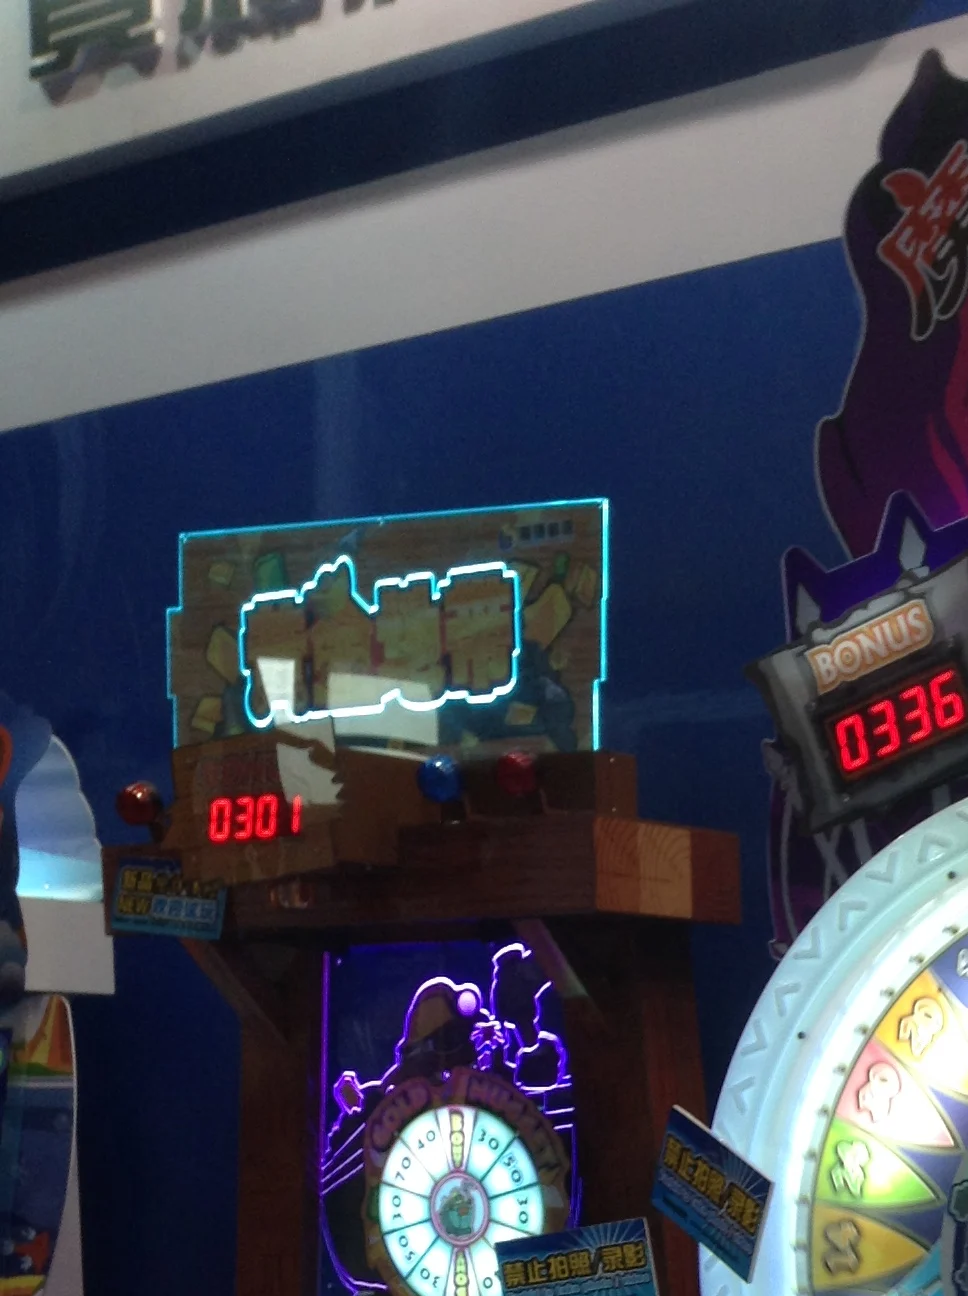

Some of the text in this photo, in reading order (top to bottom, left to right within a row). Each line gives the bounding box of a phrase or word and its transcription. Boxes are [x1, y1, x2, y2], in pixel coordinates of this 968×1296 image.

[810, 605, 933, 685] BONUS
[836, 668, 966, 772] 0336
[208, 793, 302, 843] 0301
